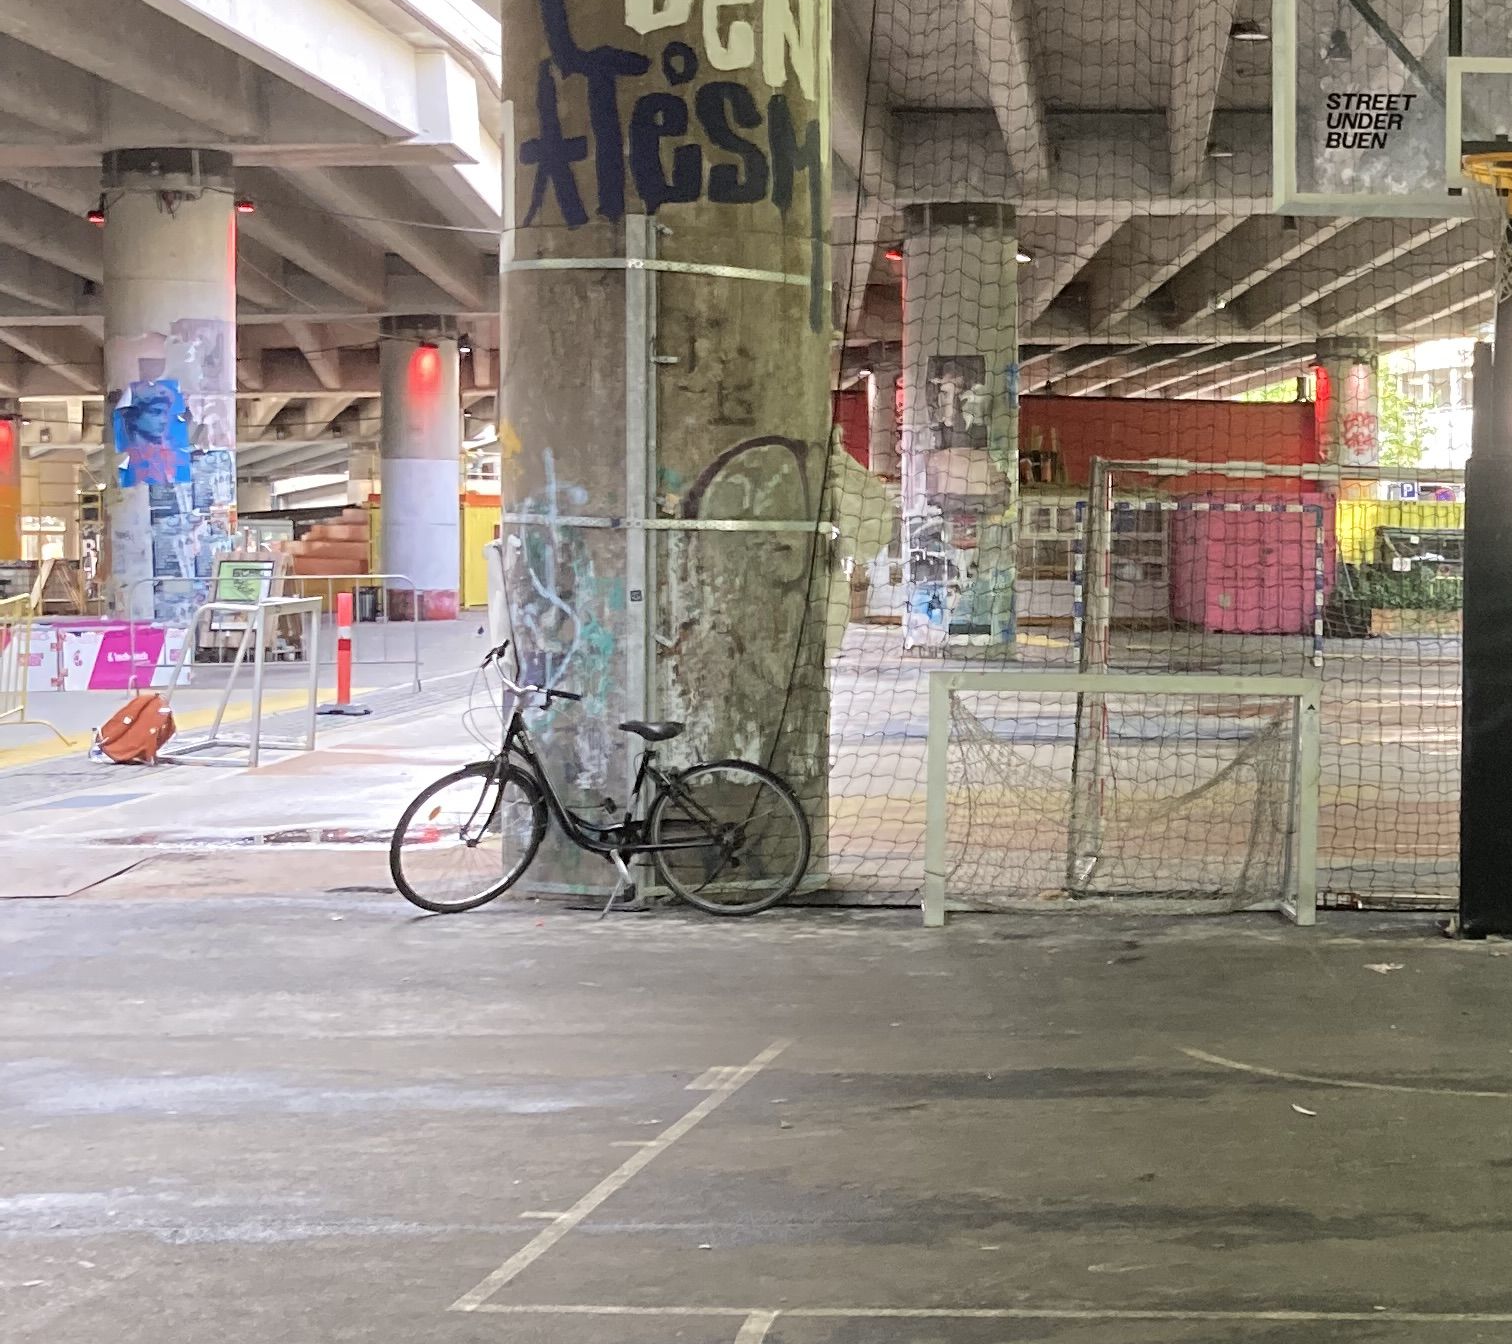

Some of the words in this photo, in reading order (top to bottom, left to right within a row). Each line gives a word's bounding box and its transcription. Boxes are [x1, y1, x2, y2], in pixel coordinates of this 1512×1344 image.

[1326, 92, 1417, 111] STREET
[1326, 112, 1404, 130] UNDER
[1325, 131, 1388, 149] BUEN
